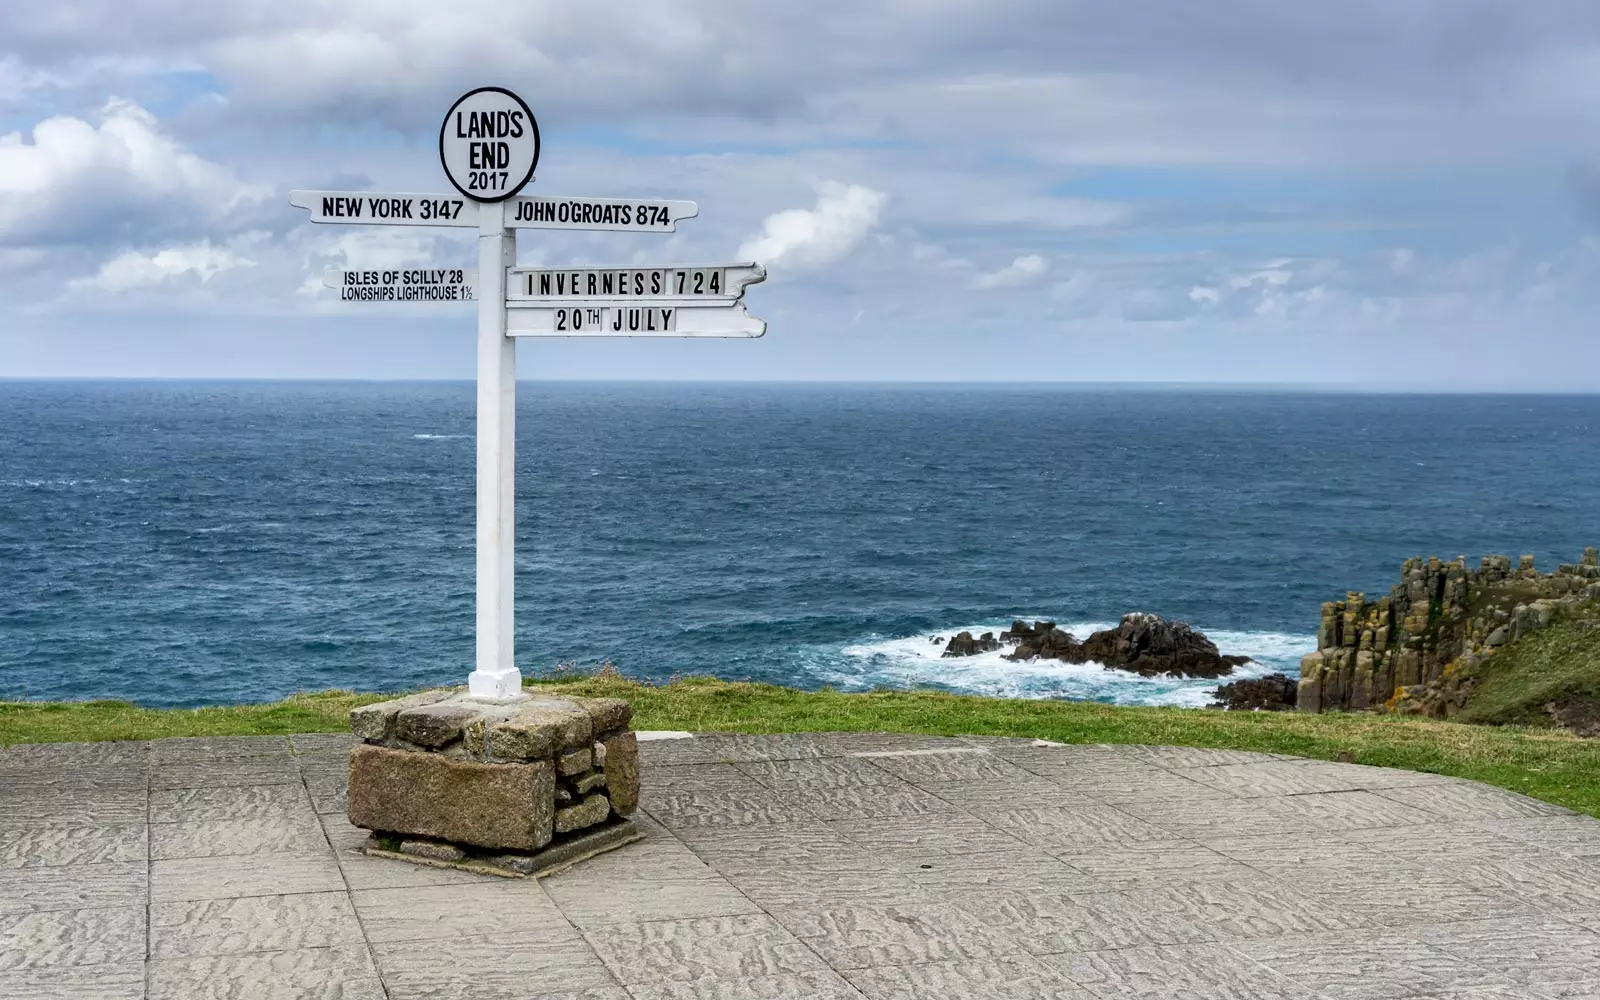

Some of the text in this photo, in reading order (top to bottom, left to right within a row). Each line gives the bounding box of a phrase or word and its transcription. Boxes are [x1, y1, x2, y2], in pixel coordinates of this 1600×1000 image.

[457, 109, 524, 138] LAND'S
[469, 141, 510, 169] END
[468, 171, 509, 190] 2017
[322, 197, 464, 220] NEW YORK 3147
[514, 201, 670, 226] JOHN O'GROATS 874
[344, 269, 464, 285] ISLES OF SCILLY 28
[528, 271, 720, 296] INVERNESS 724
[341, 286, 395, 300] LONGSHIPS
[397, 286, 458, 300] LIGHTHOUSE
[613, 308, 673, 331] JULY
